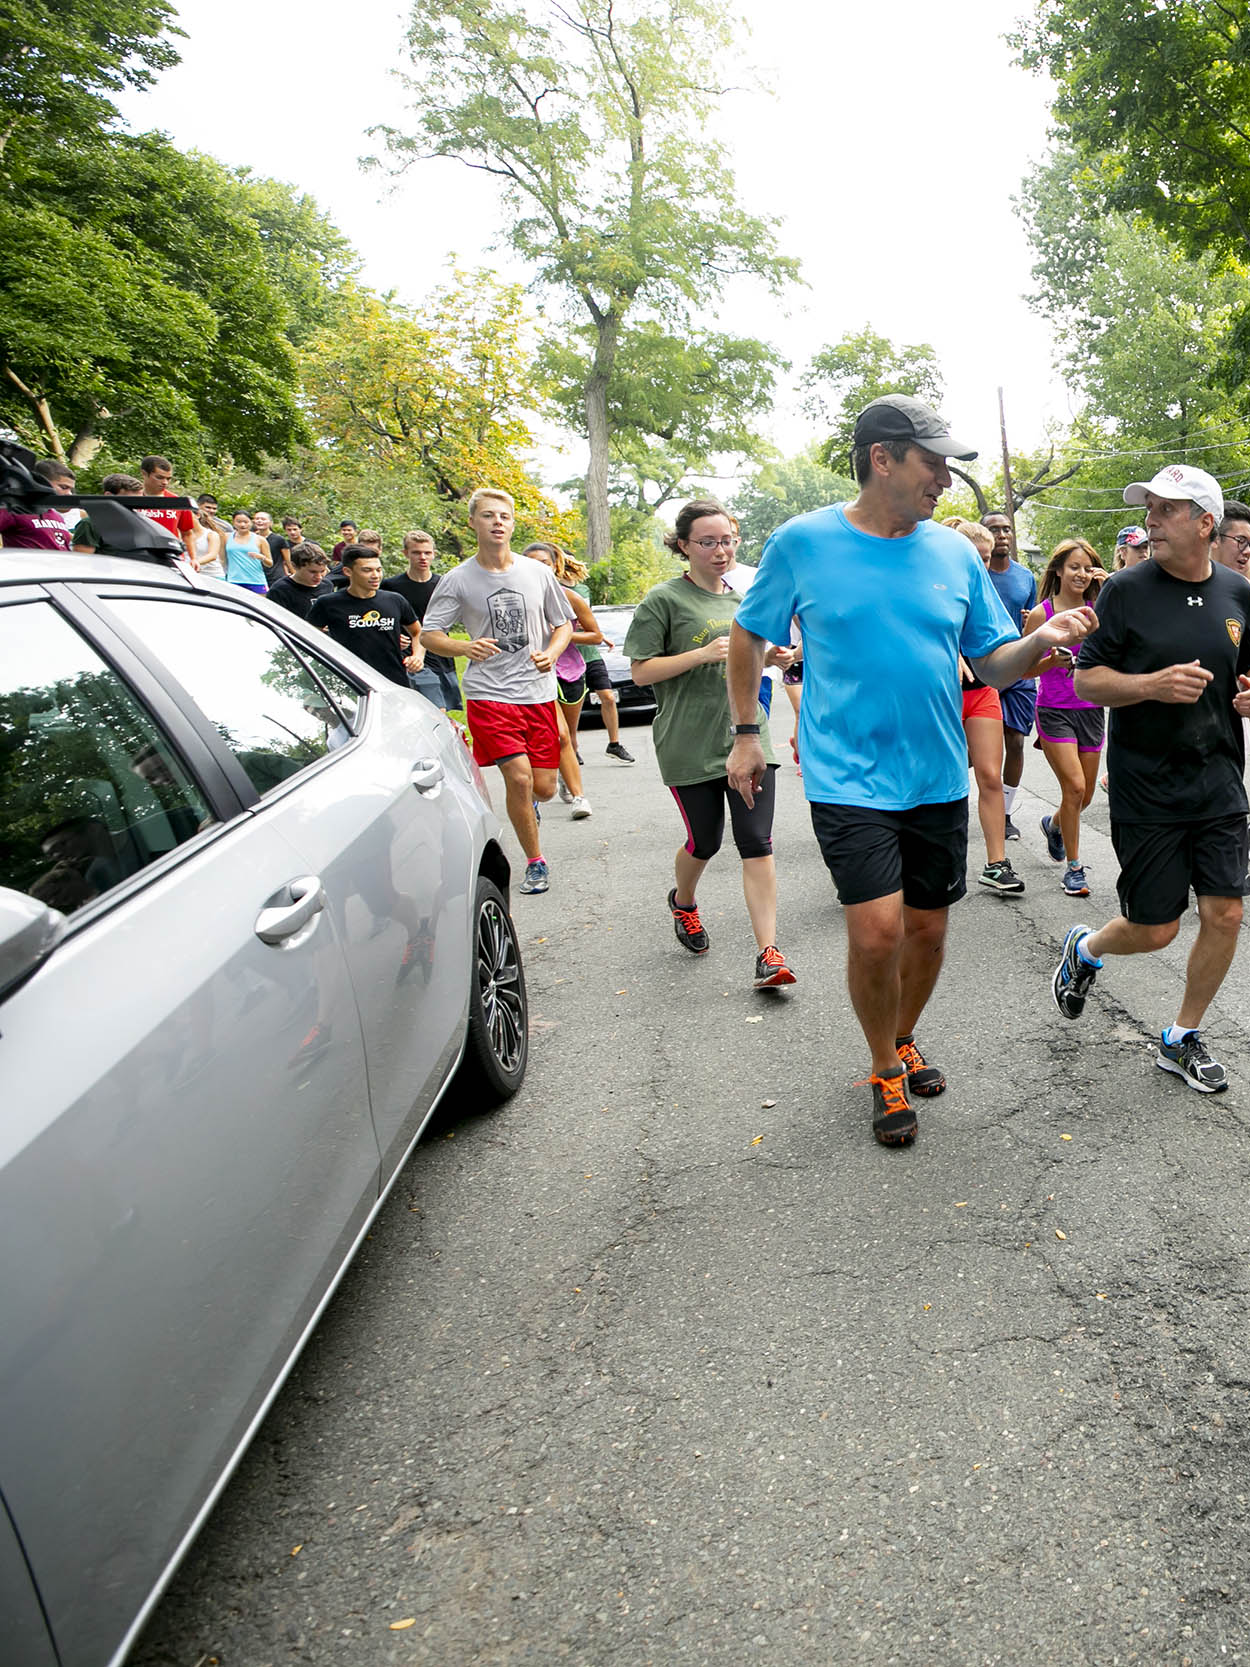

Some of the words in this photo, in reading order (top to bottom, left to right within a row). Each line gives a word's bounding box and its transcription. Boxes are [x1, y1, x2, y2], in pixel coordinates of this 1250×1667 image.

[494, 608, 522, 620] RACE
[348, 617, 395, 628] SQUASH
[691, 628, 709, 644] Run
